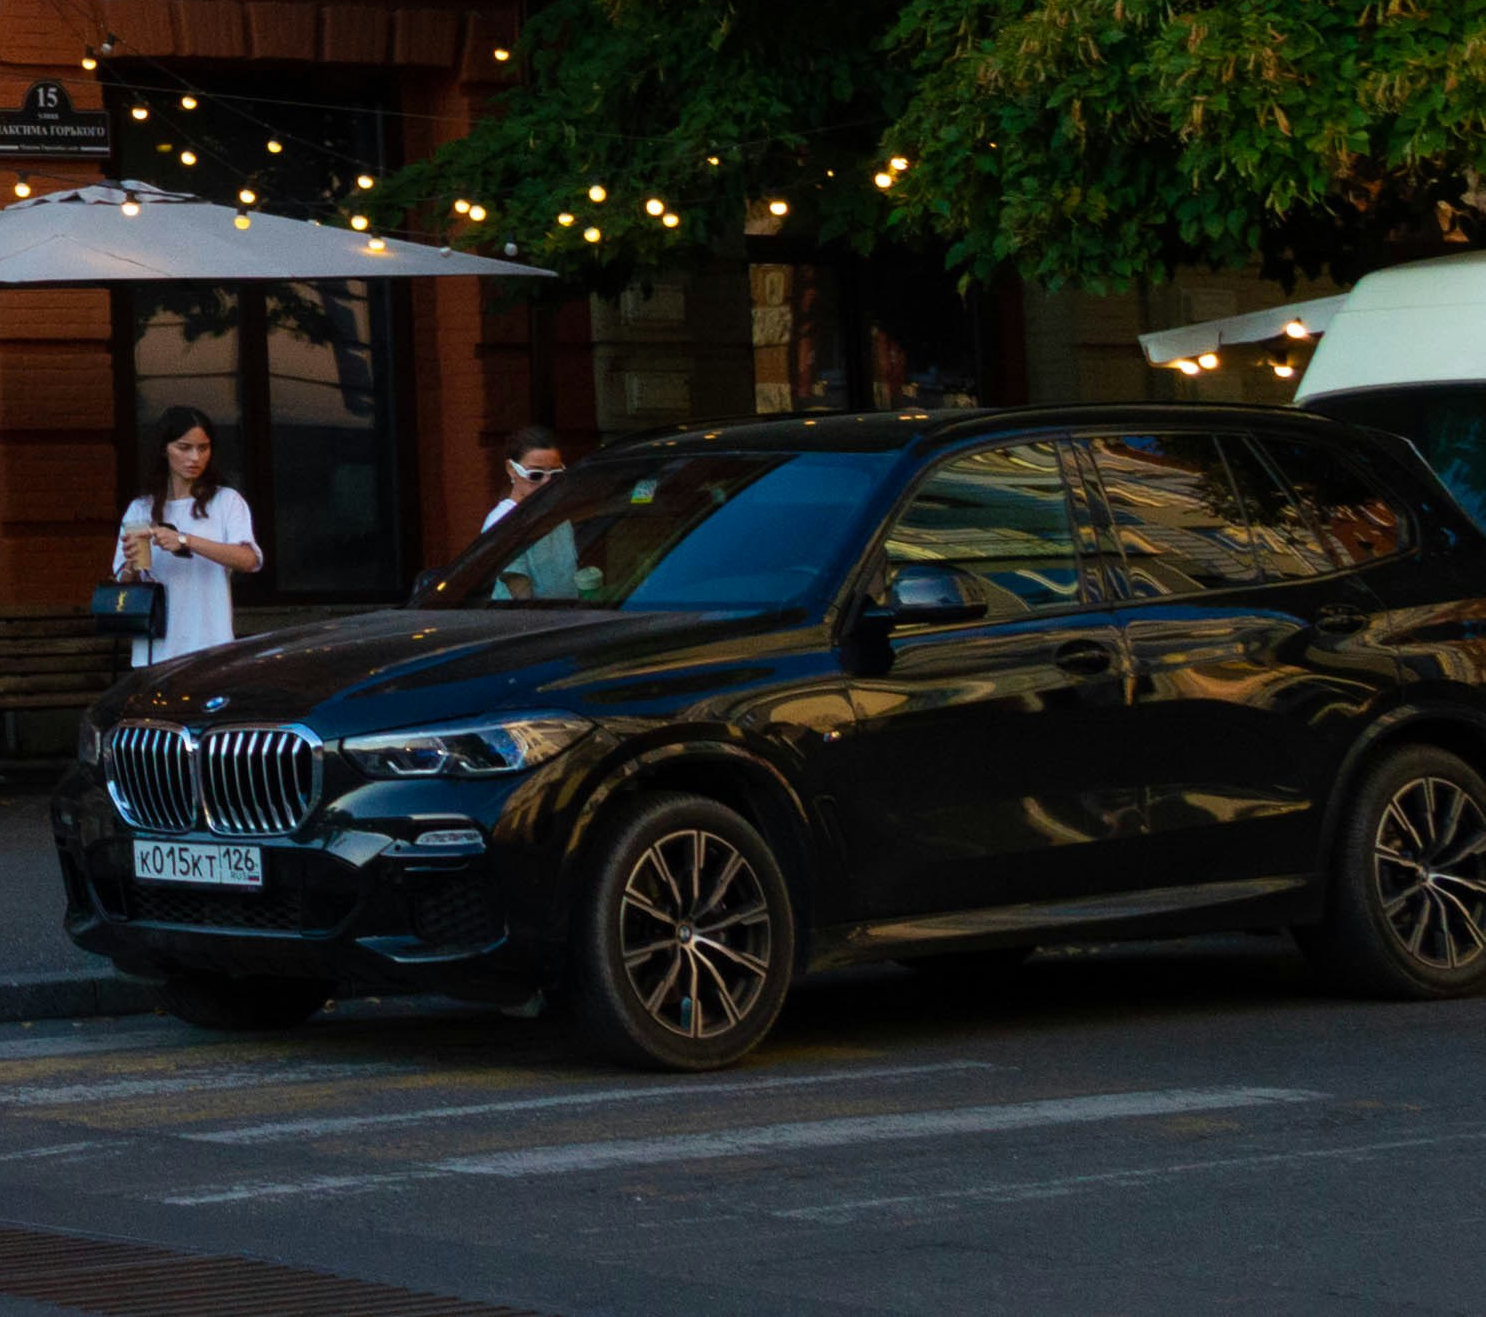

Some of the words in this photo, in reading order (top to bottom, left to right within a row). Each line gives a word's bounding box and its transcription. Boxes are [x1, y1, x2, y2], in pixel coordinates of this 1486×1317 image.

[37, 87, 58, 108] 15
[50, 125, 106, 137] ГОРЬКОГО
[223, 848, 255, 871] 126
